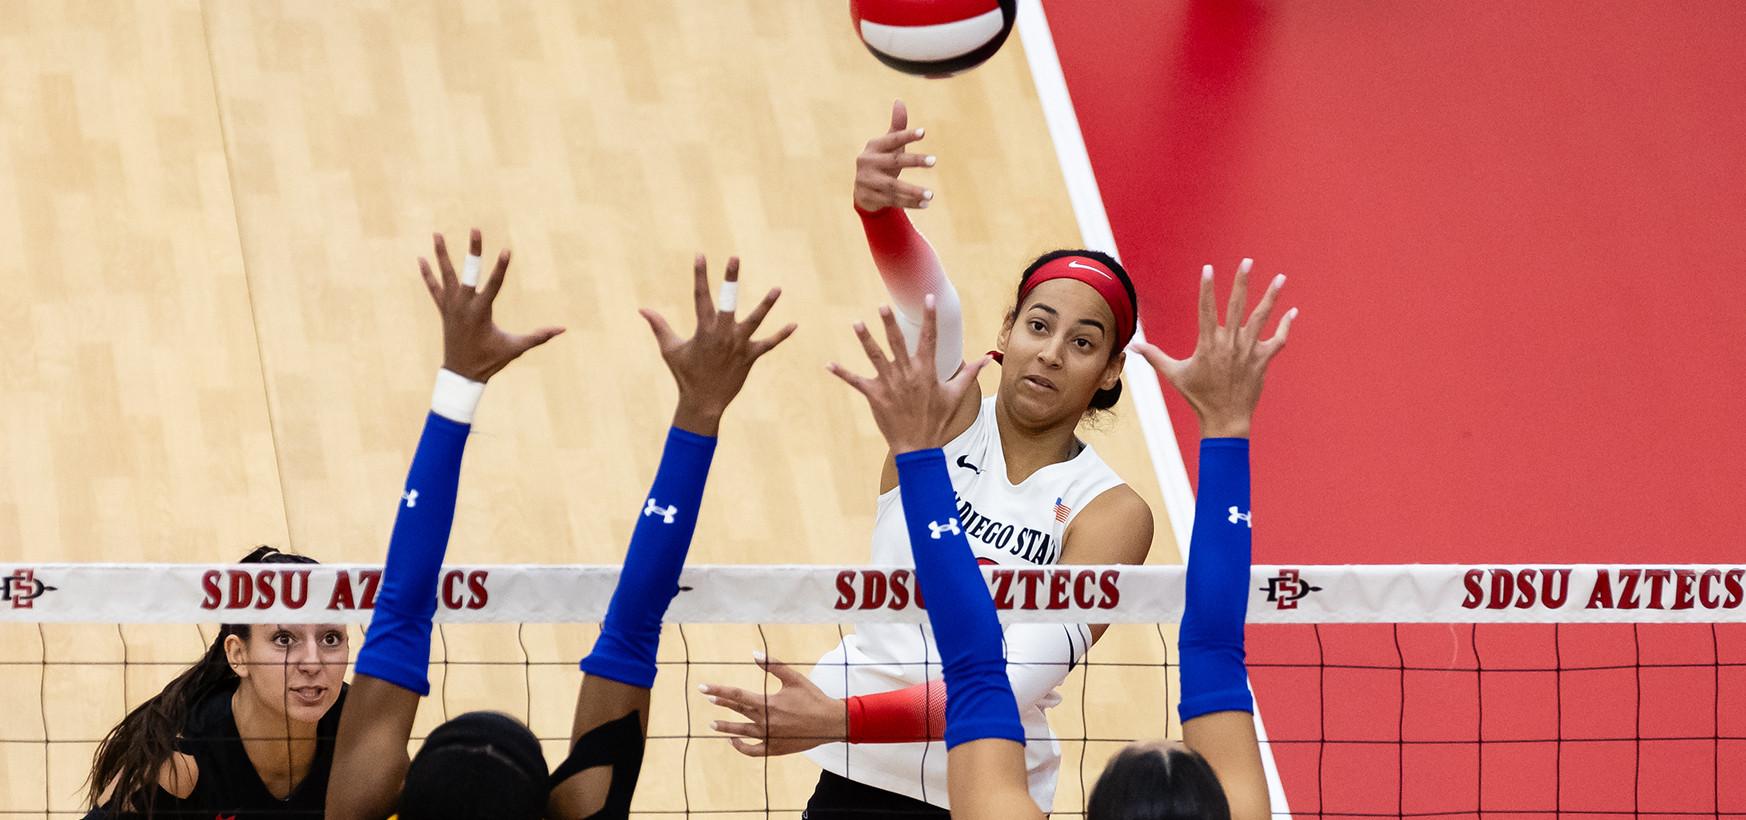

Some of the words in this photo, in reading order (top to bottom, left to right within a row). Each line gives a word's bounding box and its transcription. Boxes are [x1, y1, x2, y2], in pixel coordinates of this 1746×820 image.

[959, 500, 1015, 550] DIEGO
[1009, 527, 1056, 565] STA
[202, 571, 311, 610] SDSU
[329, 571, 489, 610] AZCS
[991, 571, 1120, 610] ZTECS
[1462, 569, 1570, 610] SDSU
[1586, 568, 1745, 610] AZTECS
